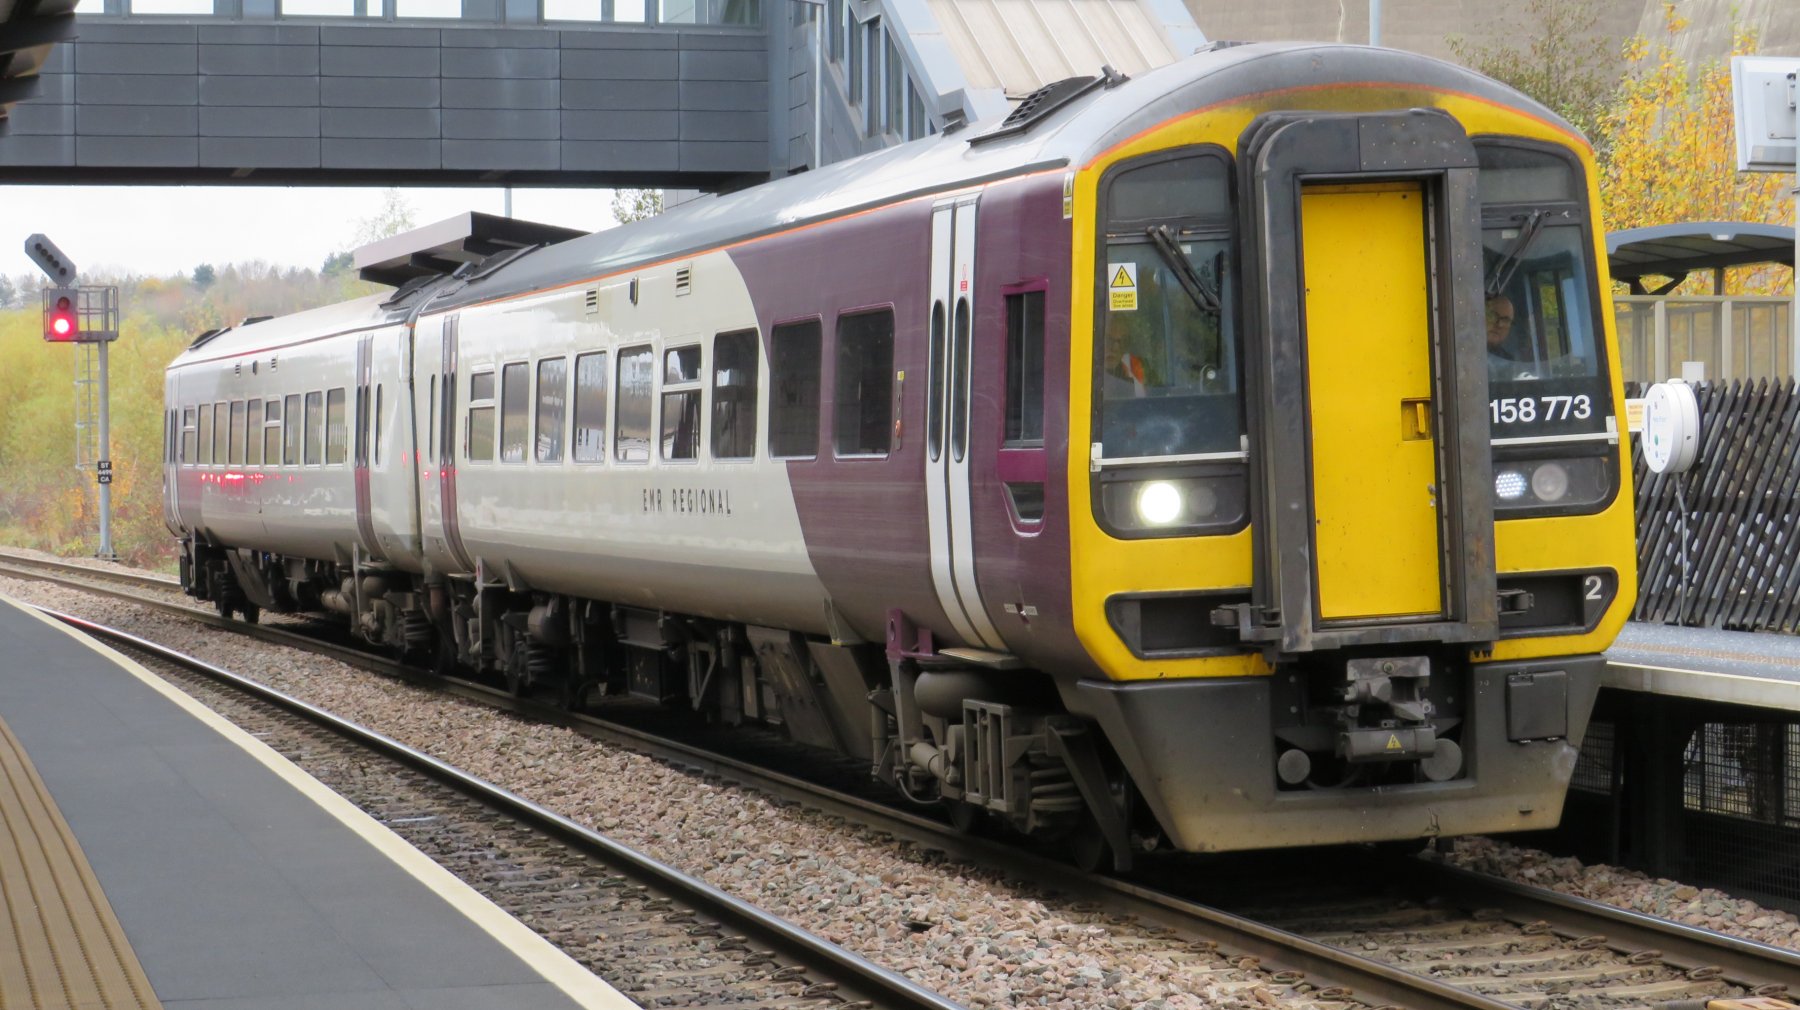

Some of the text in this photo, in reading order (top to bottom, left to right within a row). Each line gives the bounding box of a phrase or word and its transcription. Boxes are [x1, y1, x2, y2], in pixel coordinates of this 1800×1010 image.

[1490, 394, 1592, 424] 158 773
[643, 488, 731, 515] EMR REGIONAL
[1585, 575, 1602, 600] 2
